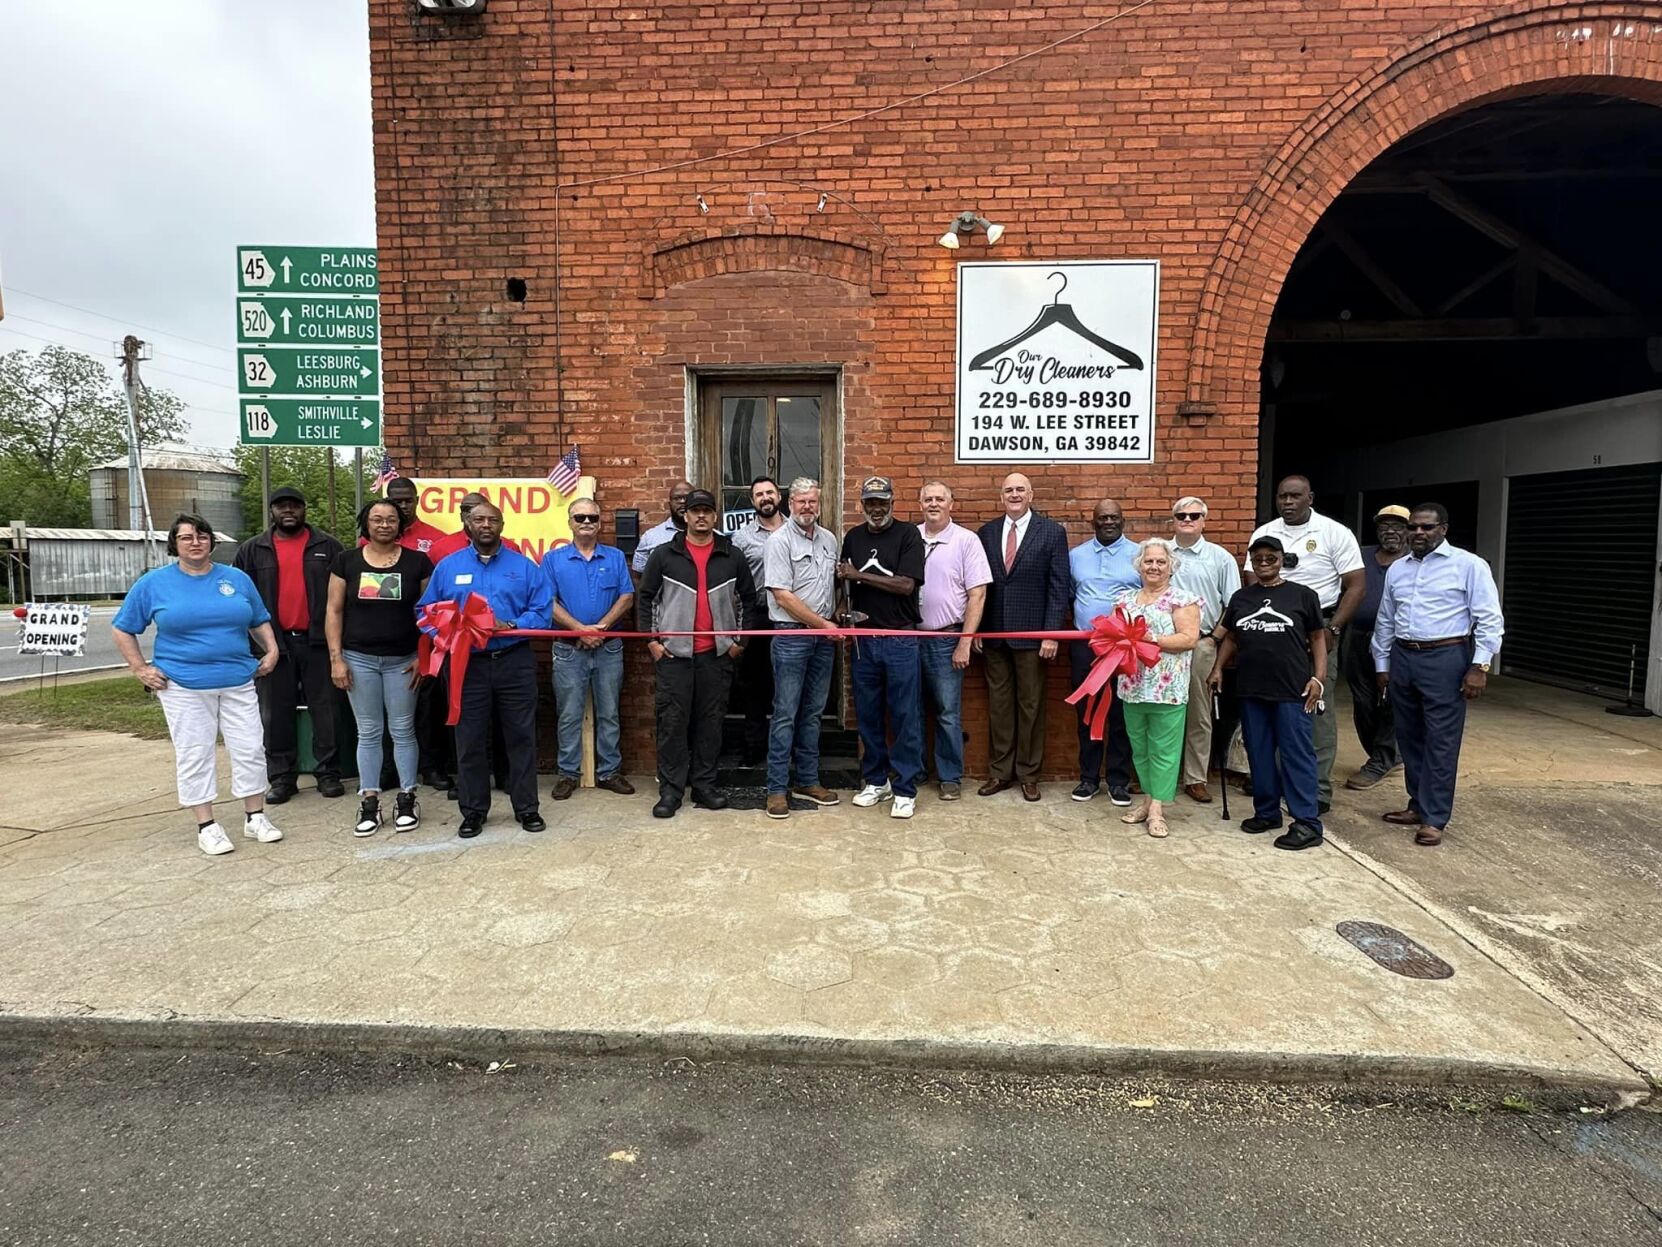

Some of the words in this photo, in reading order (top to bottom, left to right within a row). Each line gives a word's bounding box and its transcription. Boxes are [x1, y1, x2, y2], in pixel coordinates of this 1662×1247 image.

[245, 258, 264, 279] 45
[321, 254, 376, 268] PLAINS
[300, 273, 375, 288] CONCORD
[301, 304, 375, 319] RICHLAND
[244, 310, 267, 331] 520
[298, 324, 375, 339] COLUMBUS
[296, 355, 360, 369] LEESBURG
[1018, 349, 1043, 364] Our
[248, 362, 267, 381] 32
[991, 357, 1035, 385] Dry
[1039, 357, 1116, 385] Cleaners
[296, 375, 358, 389] ASHBURN
[978, 391, 1132, 409] 229-689-8930
[298, 406, 359, 420] SMITHVILLE
[248, 412, 269, 431] 118
[971, 415, 1004, 430] 194
[1010, 415, 1030, 429] W.
[1036, 415, 1067, 429] LEE
[1073, 414, 1139, 429] STREET
[298, 426, 341, 439] LESLIE
[968, 436, 1049, 453] DAWSON,
[1056, 436, 1078, 450] GA
[1084, 436, 1140, 450] 39842
[726, 512, 757, 531] OPE
[30, 613, 79, 625] GRAND
[26, 633, 78, 646] OPENING
